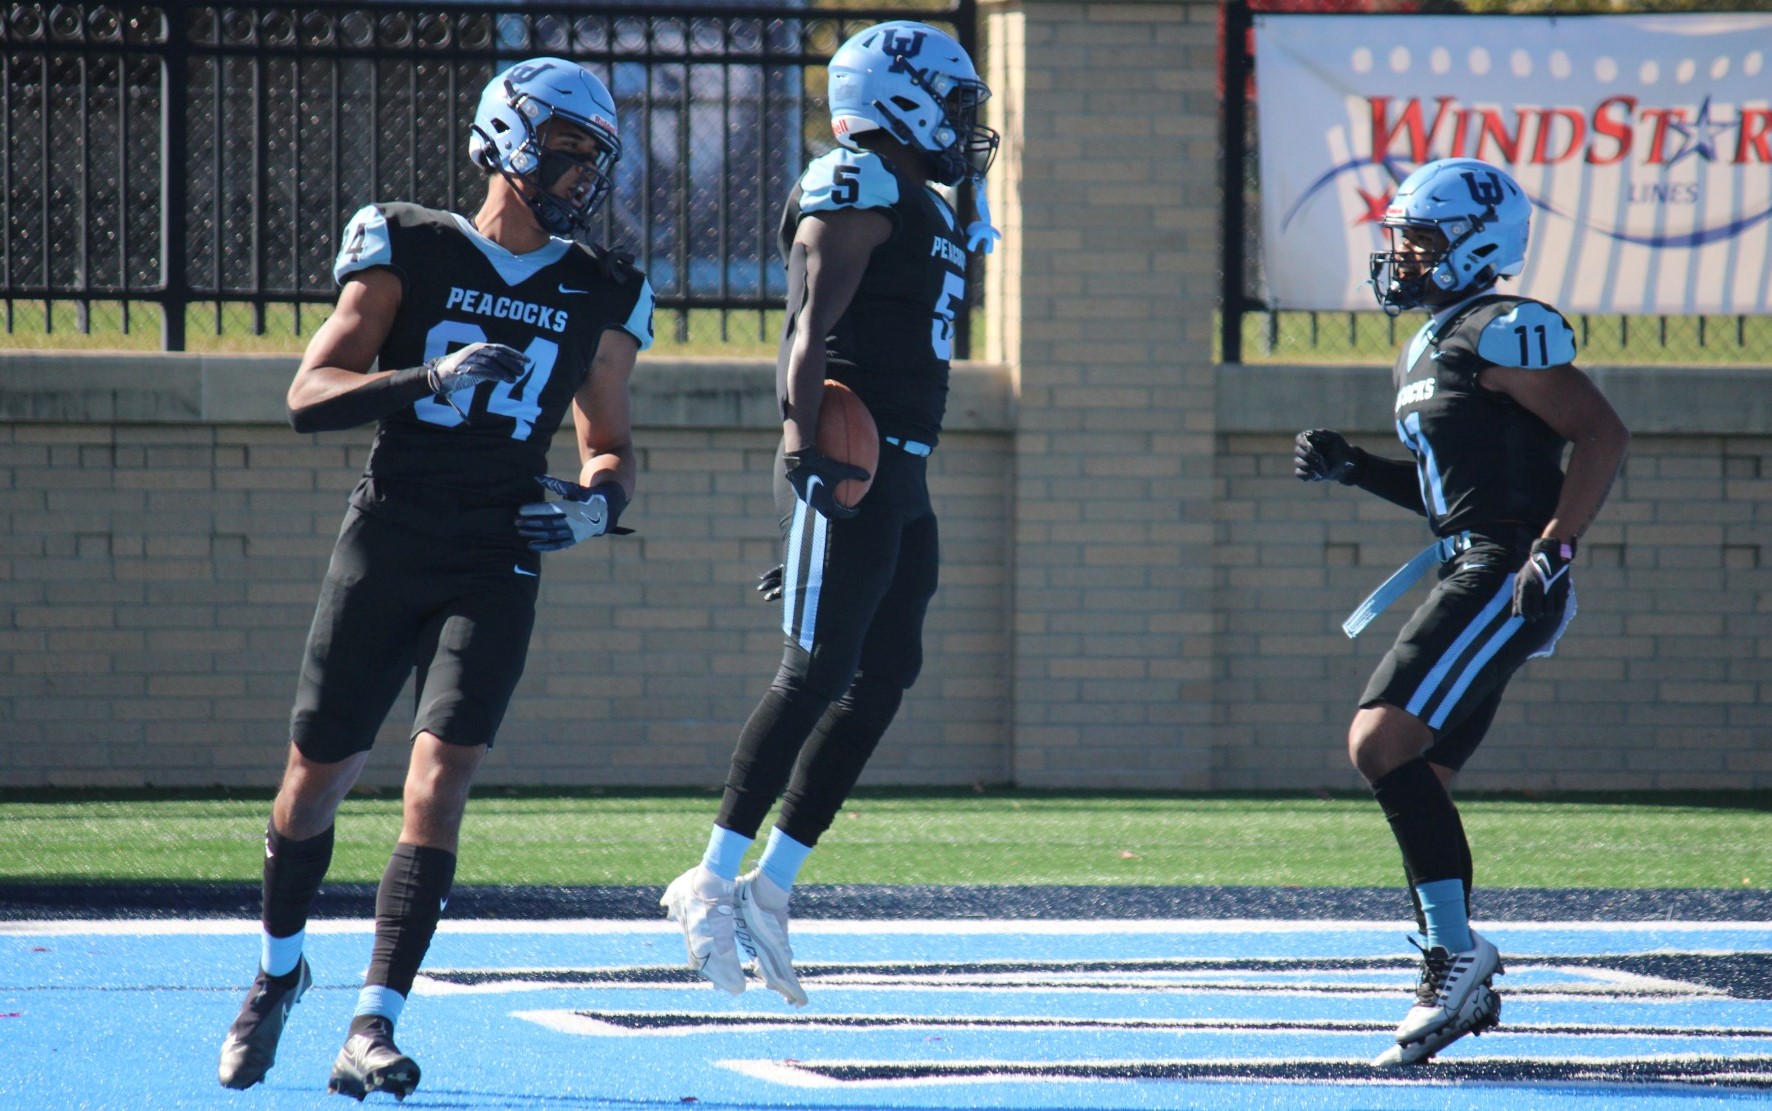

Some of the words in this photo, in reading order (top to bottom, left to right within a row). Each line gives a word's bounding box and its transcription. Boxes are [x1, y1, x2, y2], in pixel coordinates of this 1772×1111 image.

[830, 164, 861, 206] 5
[1627, 182, 1700, 204] LINES
[446, 286, 569, 333] PEACOCKS
[931, 270, 966, 361] 5
[1514, 324, 1549, 367] 11
